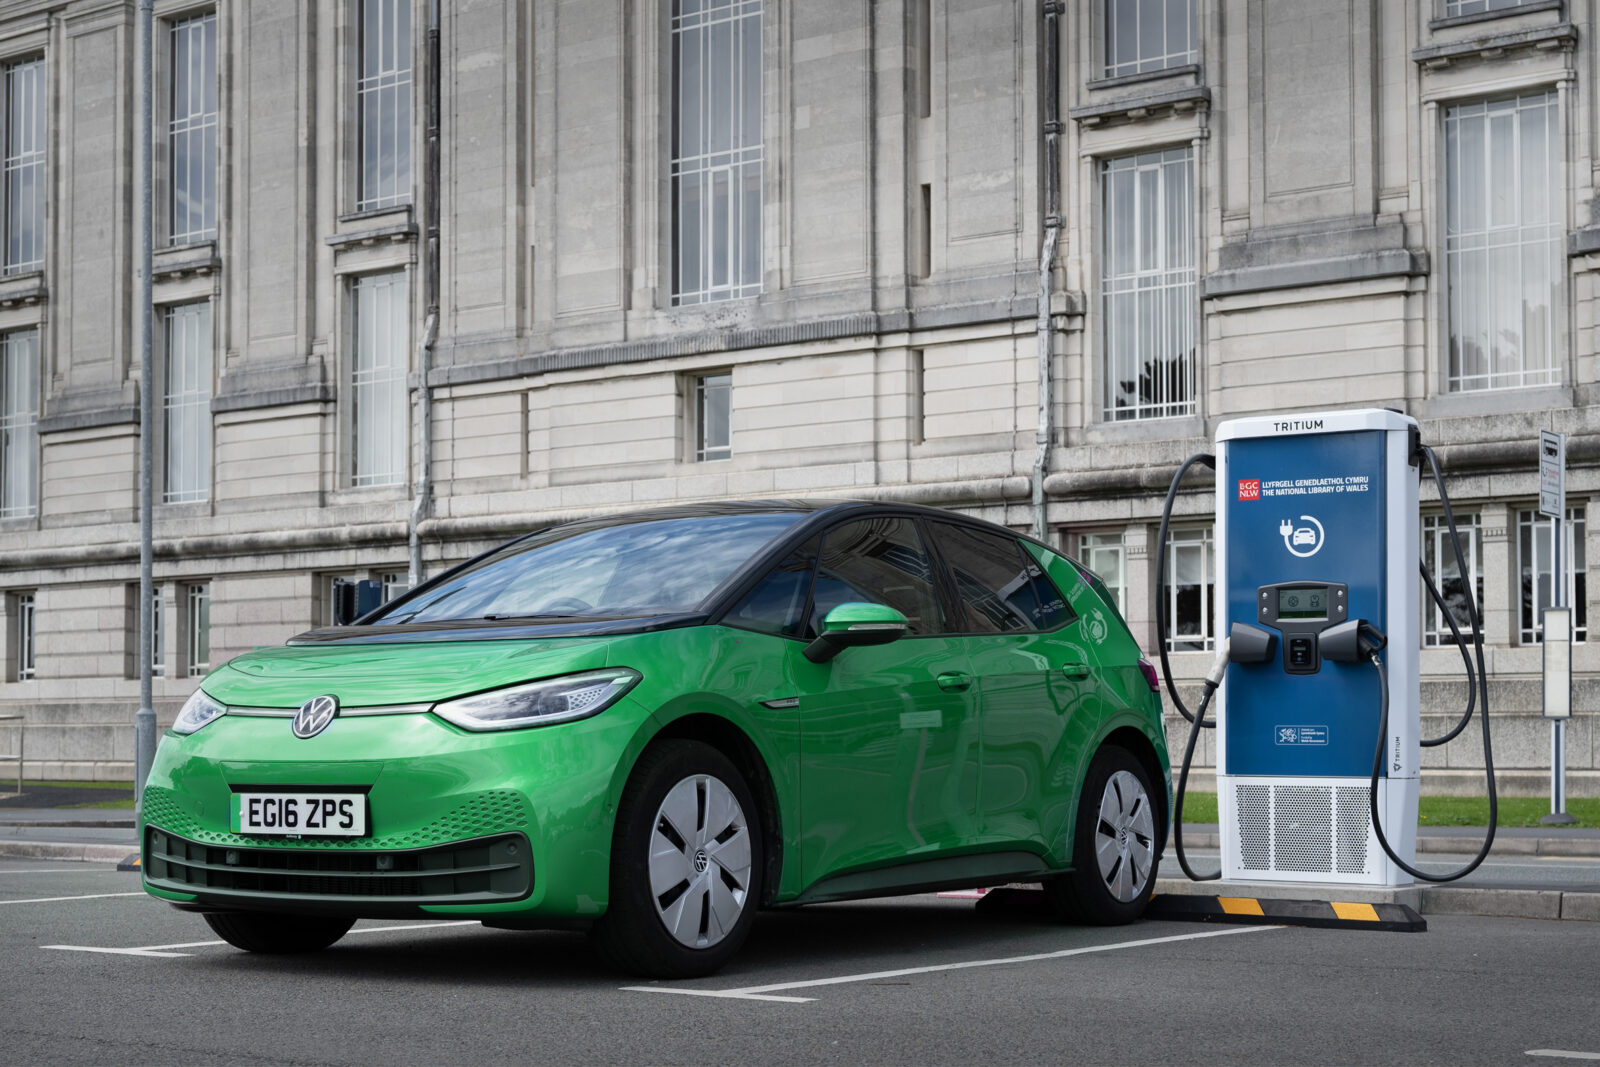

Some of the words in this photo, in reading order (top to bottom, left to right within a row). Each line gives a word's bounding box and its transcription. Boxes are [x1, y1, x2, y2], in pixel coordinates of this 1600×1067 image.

[1274, 420, 1323, 431] TRITIUM
[1262, 480, 1294, 488] LLYFRGELL
[1296, 478, 1344, 487] GENEDLAETHOL
[1240, 490, 1258, 498] NLW
[1308, 486, 1334, 494] LIBRARY
[249, 798, 298, 828] EG16
[306, 799, 354, 828] ZPS
